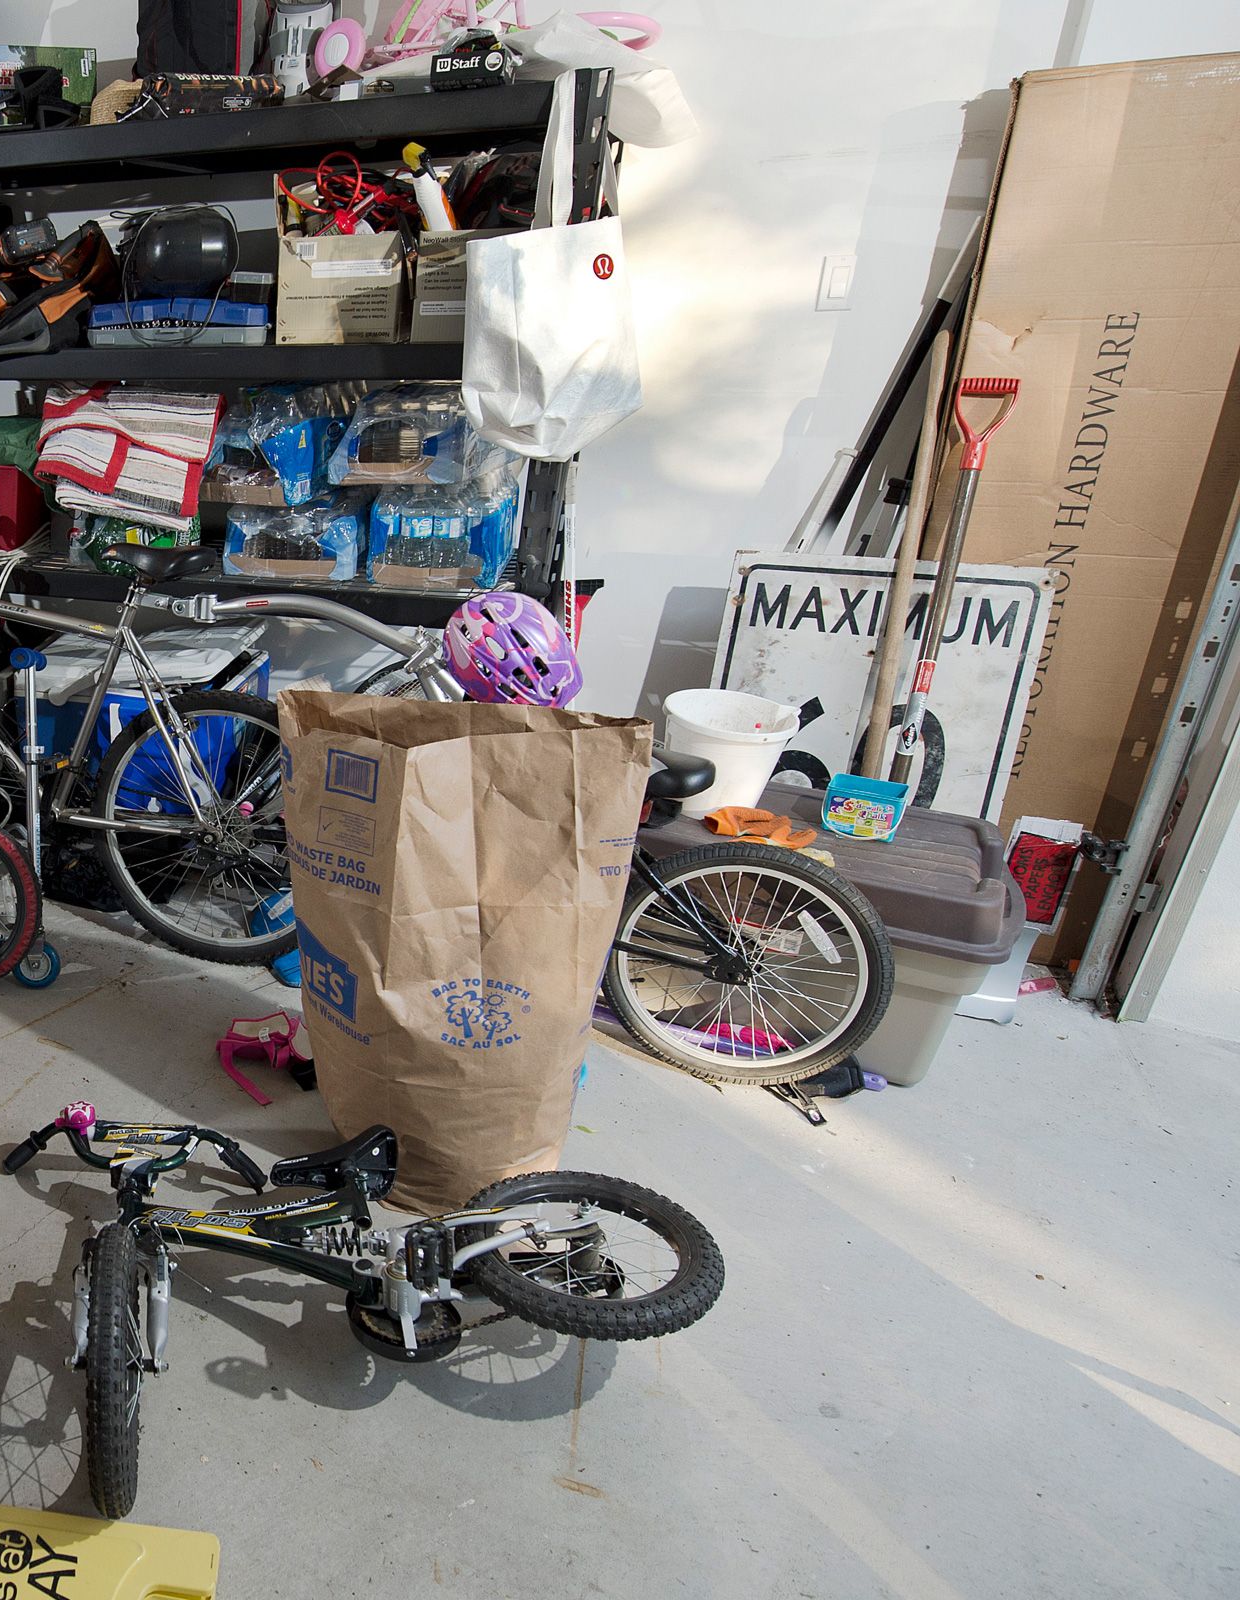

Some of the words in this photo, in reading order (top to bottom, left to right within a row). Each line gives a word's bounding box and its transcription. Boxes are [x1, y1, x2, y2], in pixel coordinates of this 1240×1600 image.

[452, 57, 481, 70] Staff
[1053, 311, 1141, 530] HARDWARE
[904, 724, 916, 748] Garant
[295, 840, 334, 865] WASTE
[337, 853, 366, 874] BAG
[311, 866, 327, 881] DE
[328, 870, 382, 897] JARDIN
[599, 865, 621, 878] TWO
[1024, 857, 1049, 901] PAPERS
[431, 980, 458, 999] BAG
[462, 978, 482, 988] TO
[486, 978, 531, 1000] EARTH
[318, 1002, 372, 1046] Warehouse
[441, 1032, 466, 1048] SAC
[472, 1038, 492, 1049] AU
[496, 1032, 522, 1048] SOL
[285, 1202, 330, 1217] SUSPENSION
